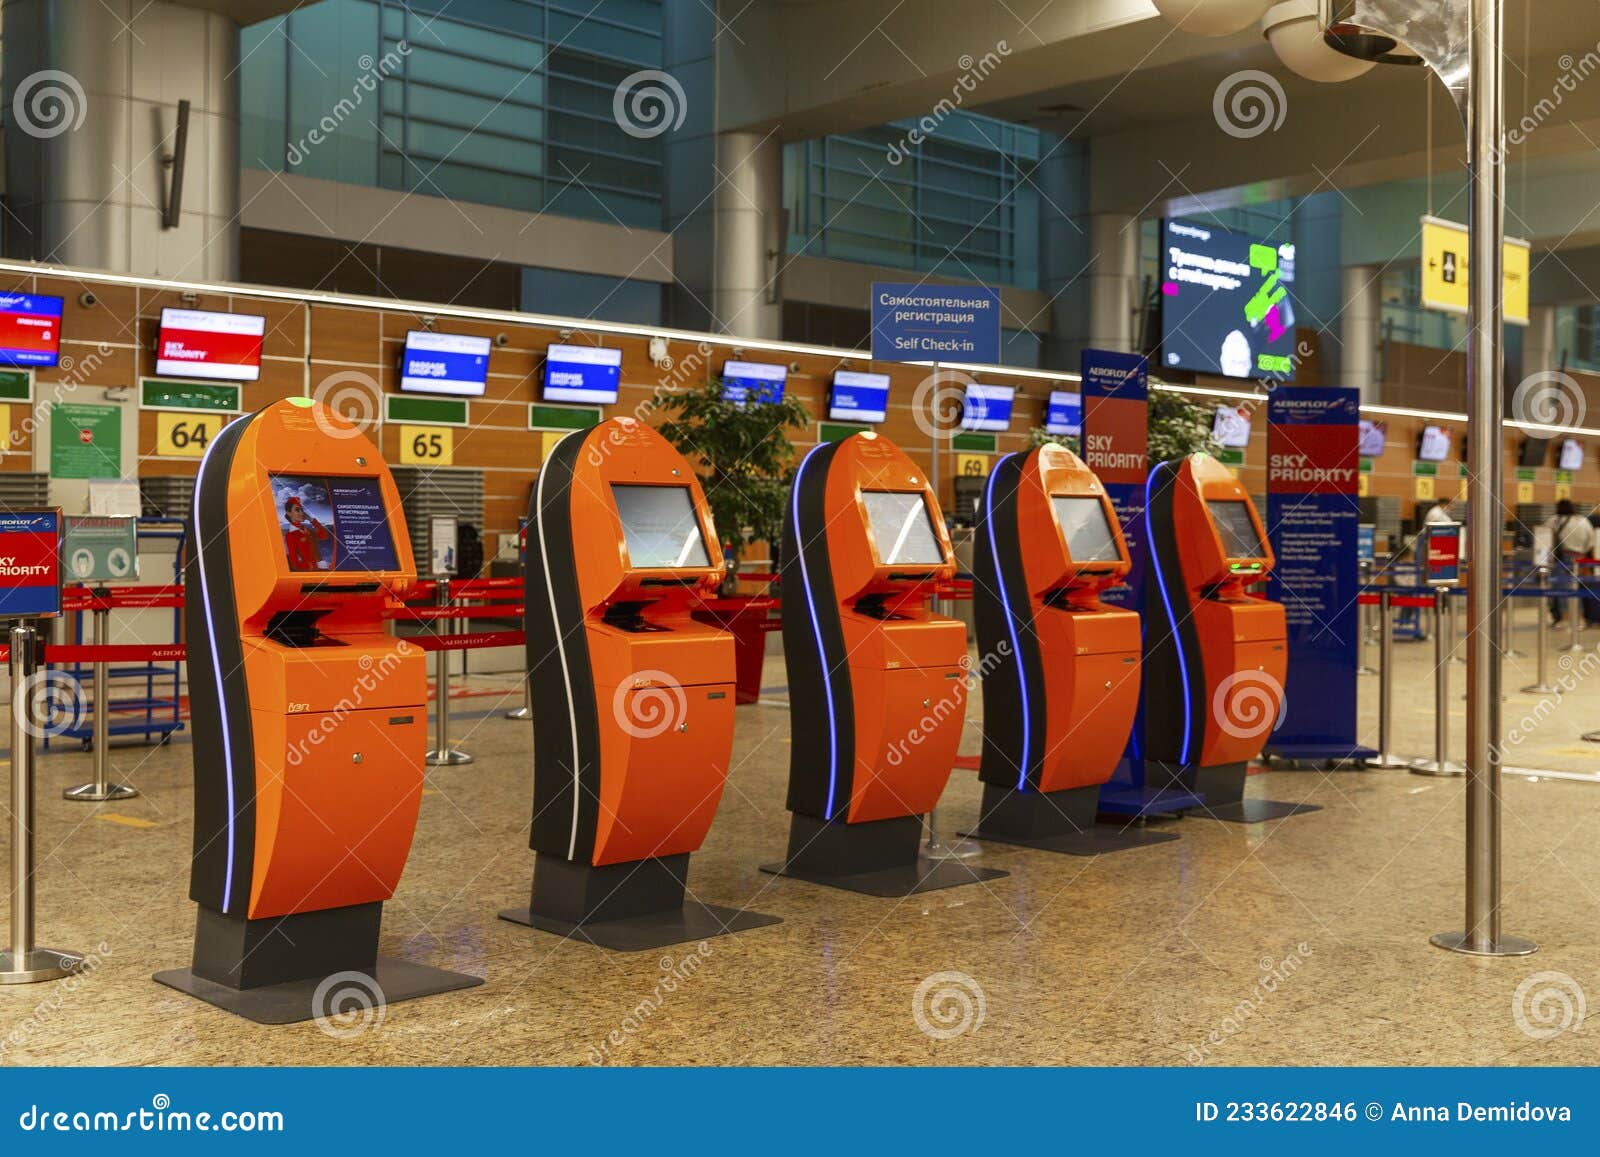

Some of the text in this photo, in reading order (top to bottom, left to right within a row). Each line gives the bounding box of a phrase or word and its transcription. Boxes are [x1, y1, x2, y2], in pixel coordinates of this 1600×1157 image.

[880, 293, 990, 309] Самостоятельная
[895, 311, 975, 325] регистрация
[895, 337, 975, 352] Self Check-in
[1088, 367, 1128, 378] AEROFLOT
[1272, 400, 1329, 409] AEROFLOT
[171, 421, 208, 449] 64
[413, 433, 442, 458] 65
[1086, 434, 1114, 451] SKY
[1086, 451, 1144, 469] PRIORITY
[1270, 454, 1307, 468] SKY
[1270, 468, 1354, 482] PRIORITY
[0, 556, 16, 567] KY
[0, 565, 50, 577] RIORITY
